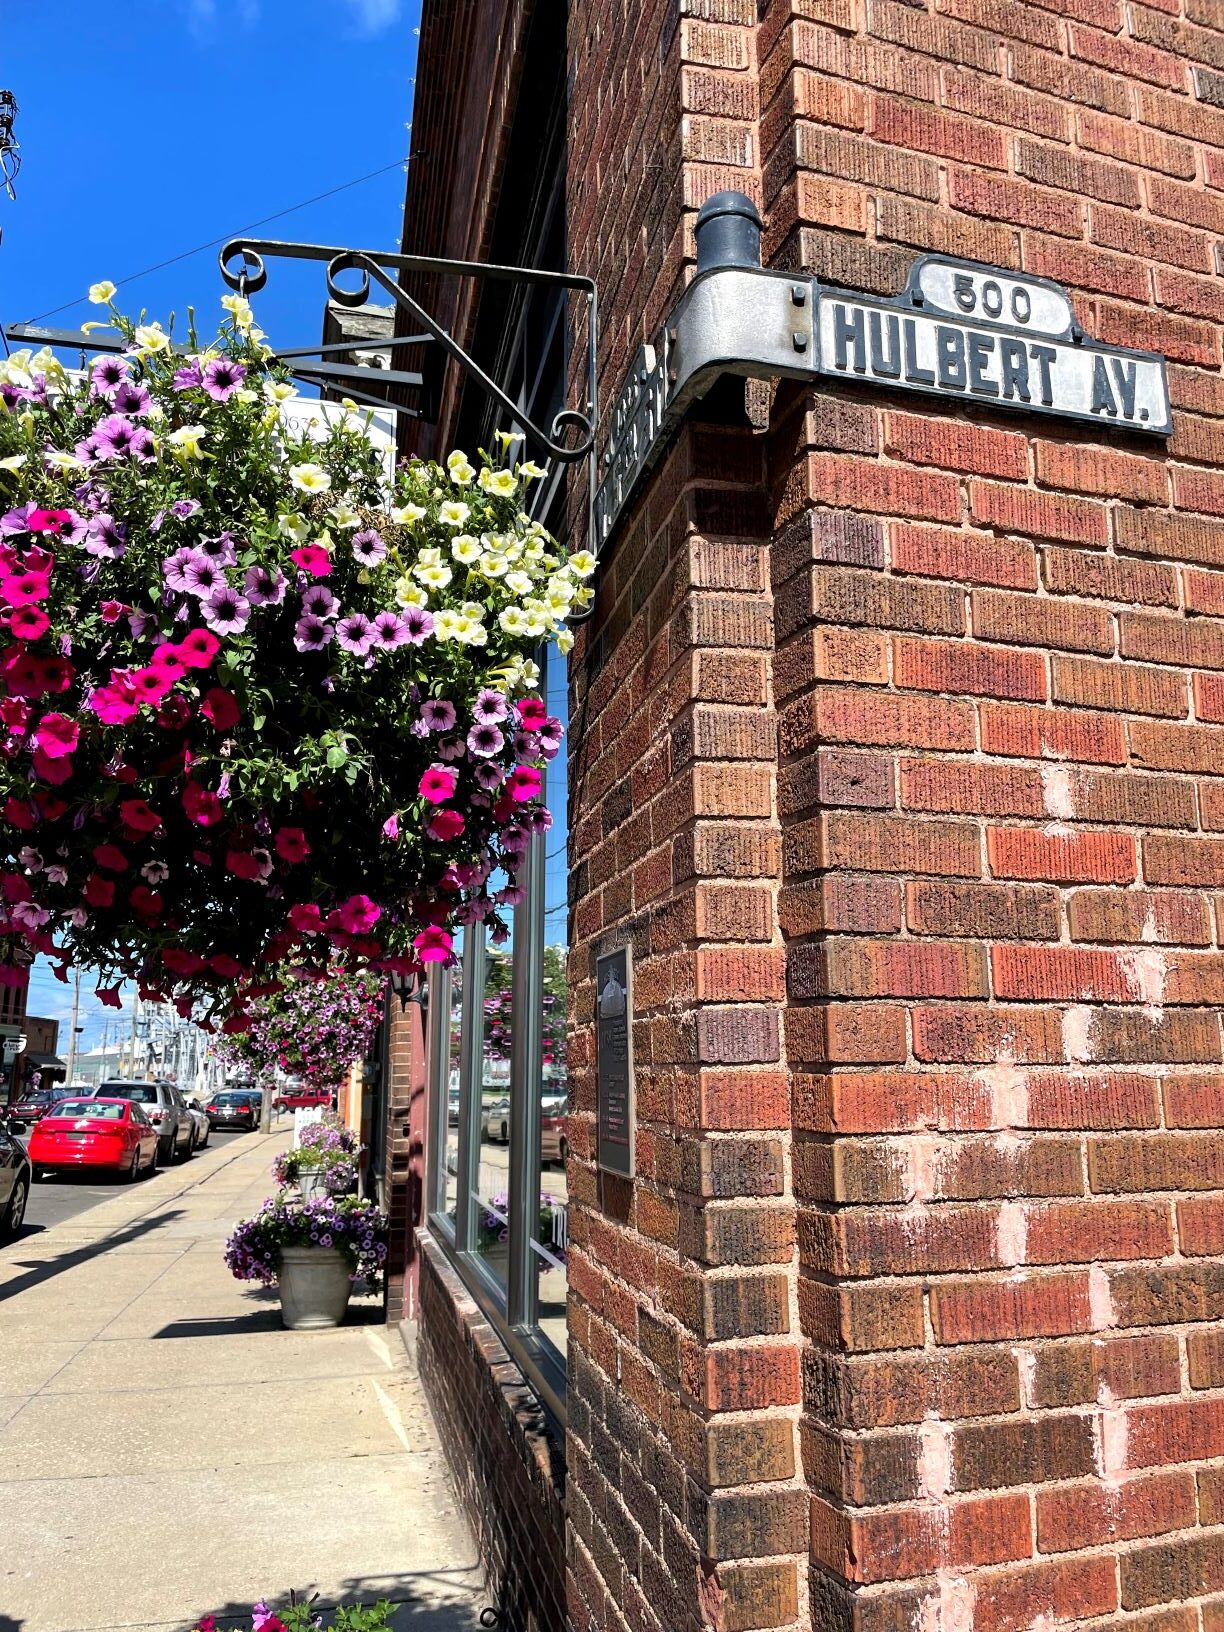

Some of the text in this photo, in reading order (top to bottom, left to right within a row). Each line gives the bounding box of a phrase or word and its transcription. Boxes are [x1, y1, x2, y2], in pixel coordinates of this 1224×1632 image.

[953, 272, 1031, 323] 500
[832, 303, 1150, 421] HULBERT AV.
